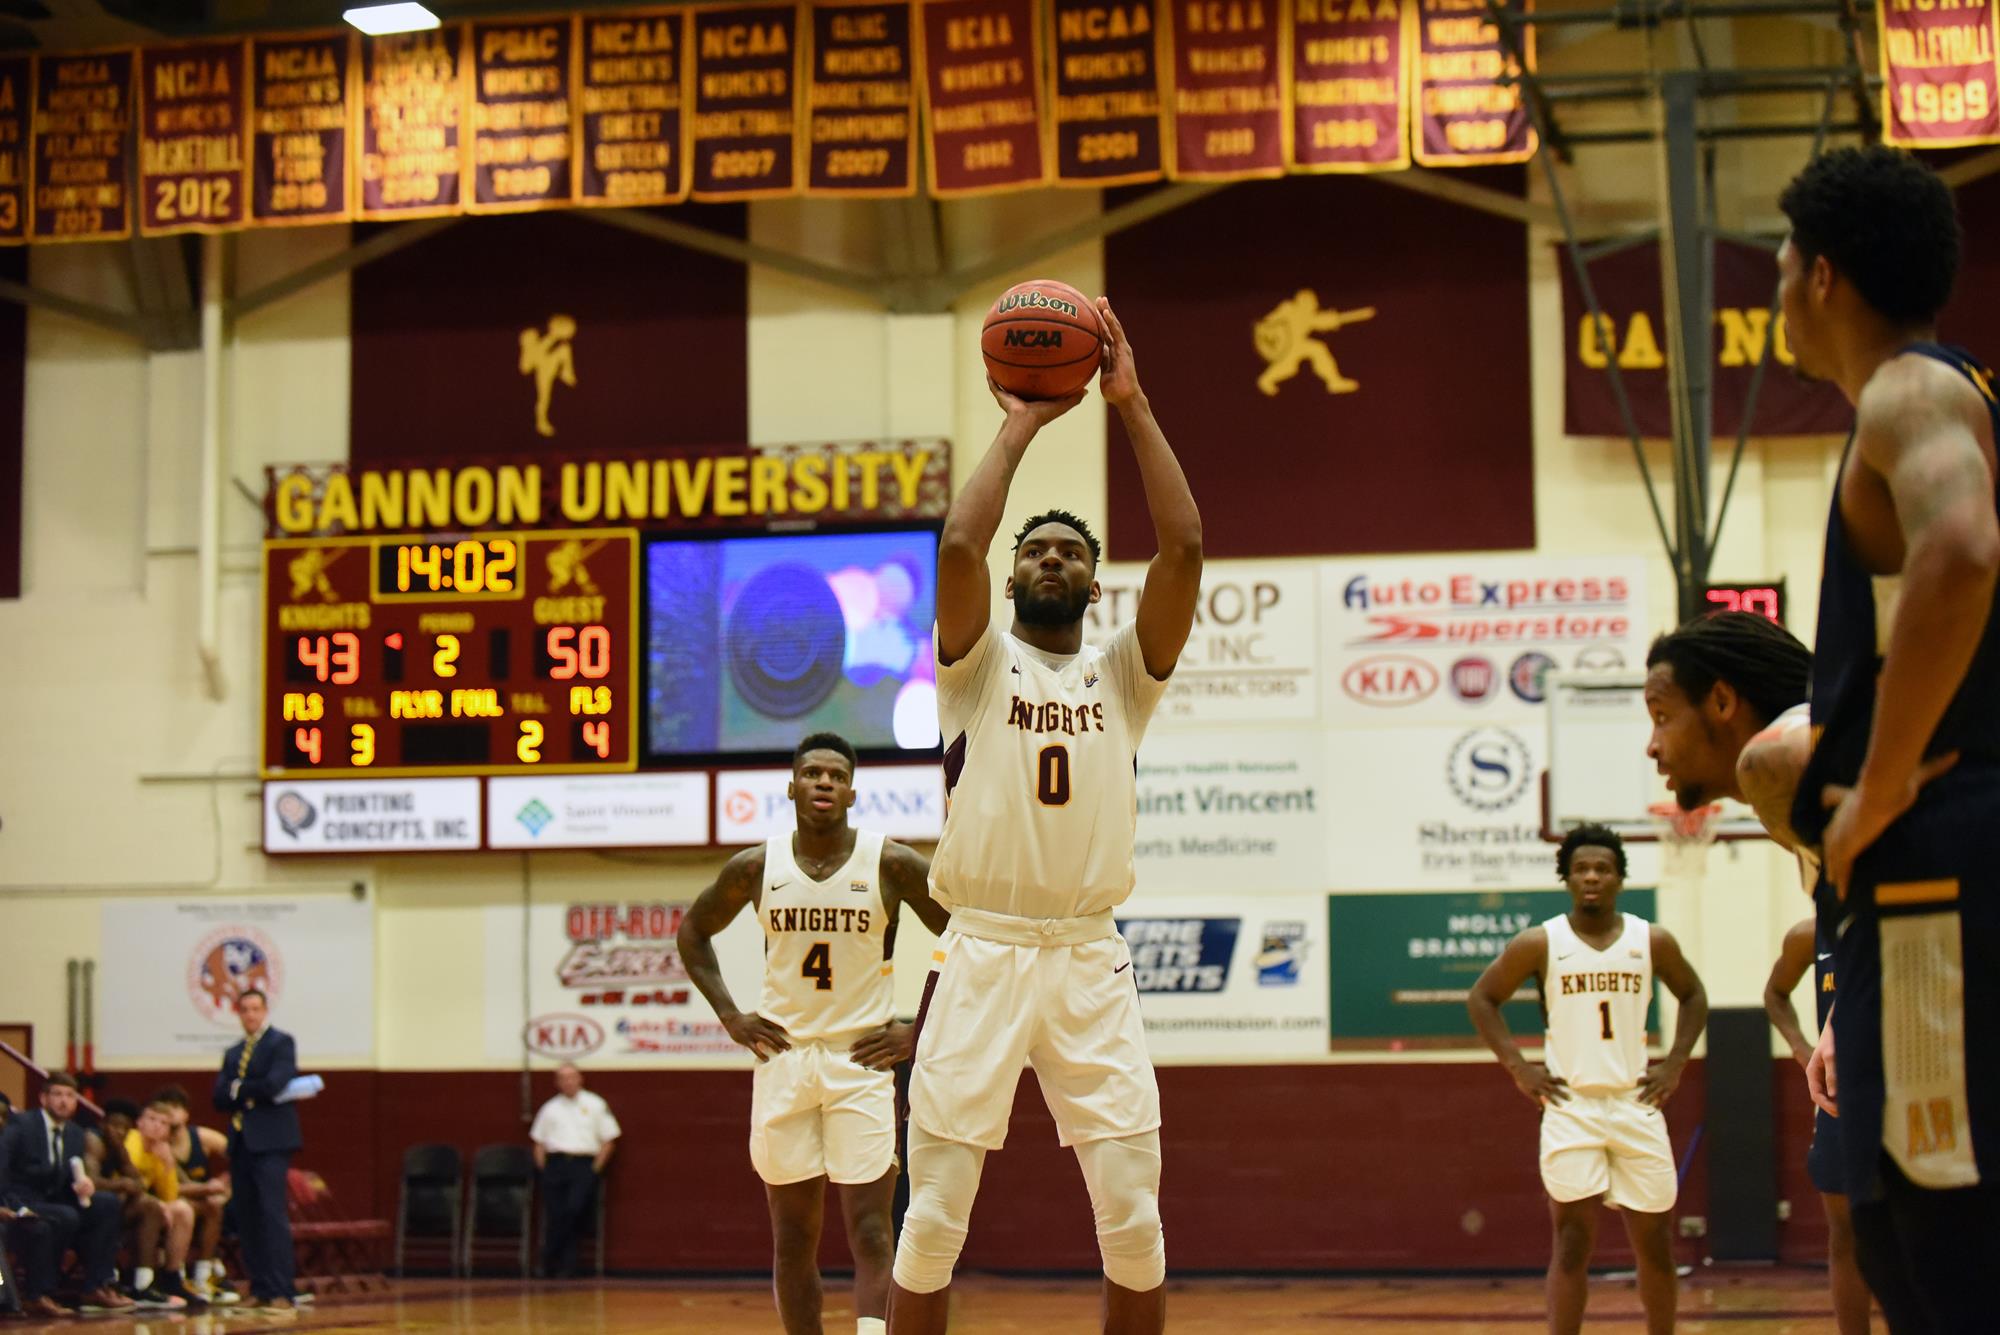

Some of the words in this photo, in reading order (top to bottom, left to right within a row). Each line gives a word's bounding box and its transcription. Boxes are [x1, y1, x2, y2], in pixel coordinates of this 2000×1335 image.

[946, 13, 1013, 50] NCAA
[1060, 4, 1151, 42] NCAA
[1187, 0, 1266, 33] NCAA
[592, 20, 673, 52] NCAA
[702, 23, 788, 59] NCAA
[1887, 23, 1993, 68] VOLLEYBALL
[155, 60, 231, 99] NCAA
[265, 49, 336, 80] NCAA
[1057, 90, 1161, 122] BASKETBALL
[1176, 82, 1279, 115] BASKETBALL
[1295, 76, 1396, 107] BASKETBALL
[1899, 78, 1990, 124] 1989
[694, 108, 794, 140] BASKETBALL
[933, 96, 1035, 133] BASKETBALL
[144, 134, 242, 174] BASKETBALL
[155, 178, 232, 220] 2012
[999, 291, 1078, 318] Wilson
[1004, 328, 1063, 349] NCAA
[276, 465, 543, 533] GANNON
[560, 450, 932, 522] UNIVERSITY
[397, 538, 518, 594] 14:02
[279, 602, 371, 631] KNIGHTS
[533, 595, 606, 625] GUEST
[297, 632, 360, 685] 43
[433, 634, 461, 678] 2
[547, 625, 611, 680] 50
[1168, 680, 1298, 698] ONTRACTORS
[1359, 668, 1421, 693] KIA
[283, 692, 325, 721] FLS
[451, 688, 504, 717] FOUL
[570, 685, 612, 715] FLS
[1007, 695, 1104, 737] KNIGHTS
[295, 727, 322, 764] 4
[350, 723, 376, 766] 3
[516, 719, 545, 763] 2
[582, 721, 611, 758] 4
[1036, 742, 1072, 808] 0
[323, 794, 414, 813] PRINTING
[566, 804, 605, 819] Saint
[612, 802, 675, 818] Vincent
[853, 790, 936, 816] ANK
[1194, 785, 1316, 813] Vincent
[1180, 836, 1276, 854] Medicine
[567, 905, 683, 941] OFF-ROA
[769, 907, 870, 934] KNIGHTS
[1122, 920, 1203, 946] ERIE
[1449, 914, 1530, 934] MOLLY
[1409, 938, 1506, 958] BRANNI
[801, 941, 833, 991] 4
[1139, 966, 1223, 991] ORTS
[1561, 972, 1643, 995] KNIGHTS
[1598, 1000, 1614, 1041] 1
[536, 1026, 590, 1048] KIA
